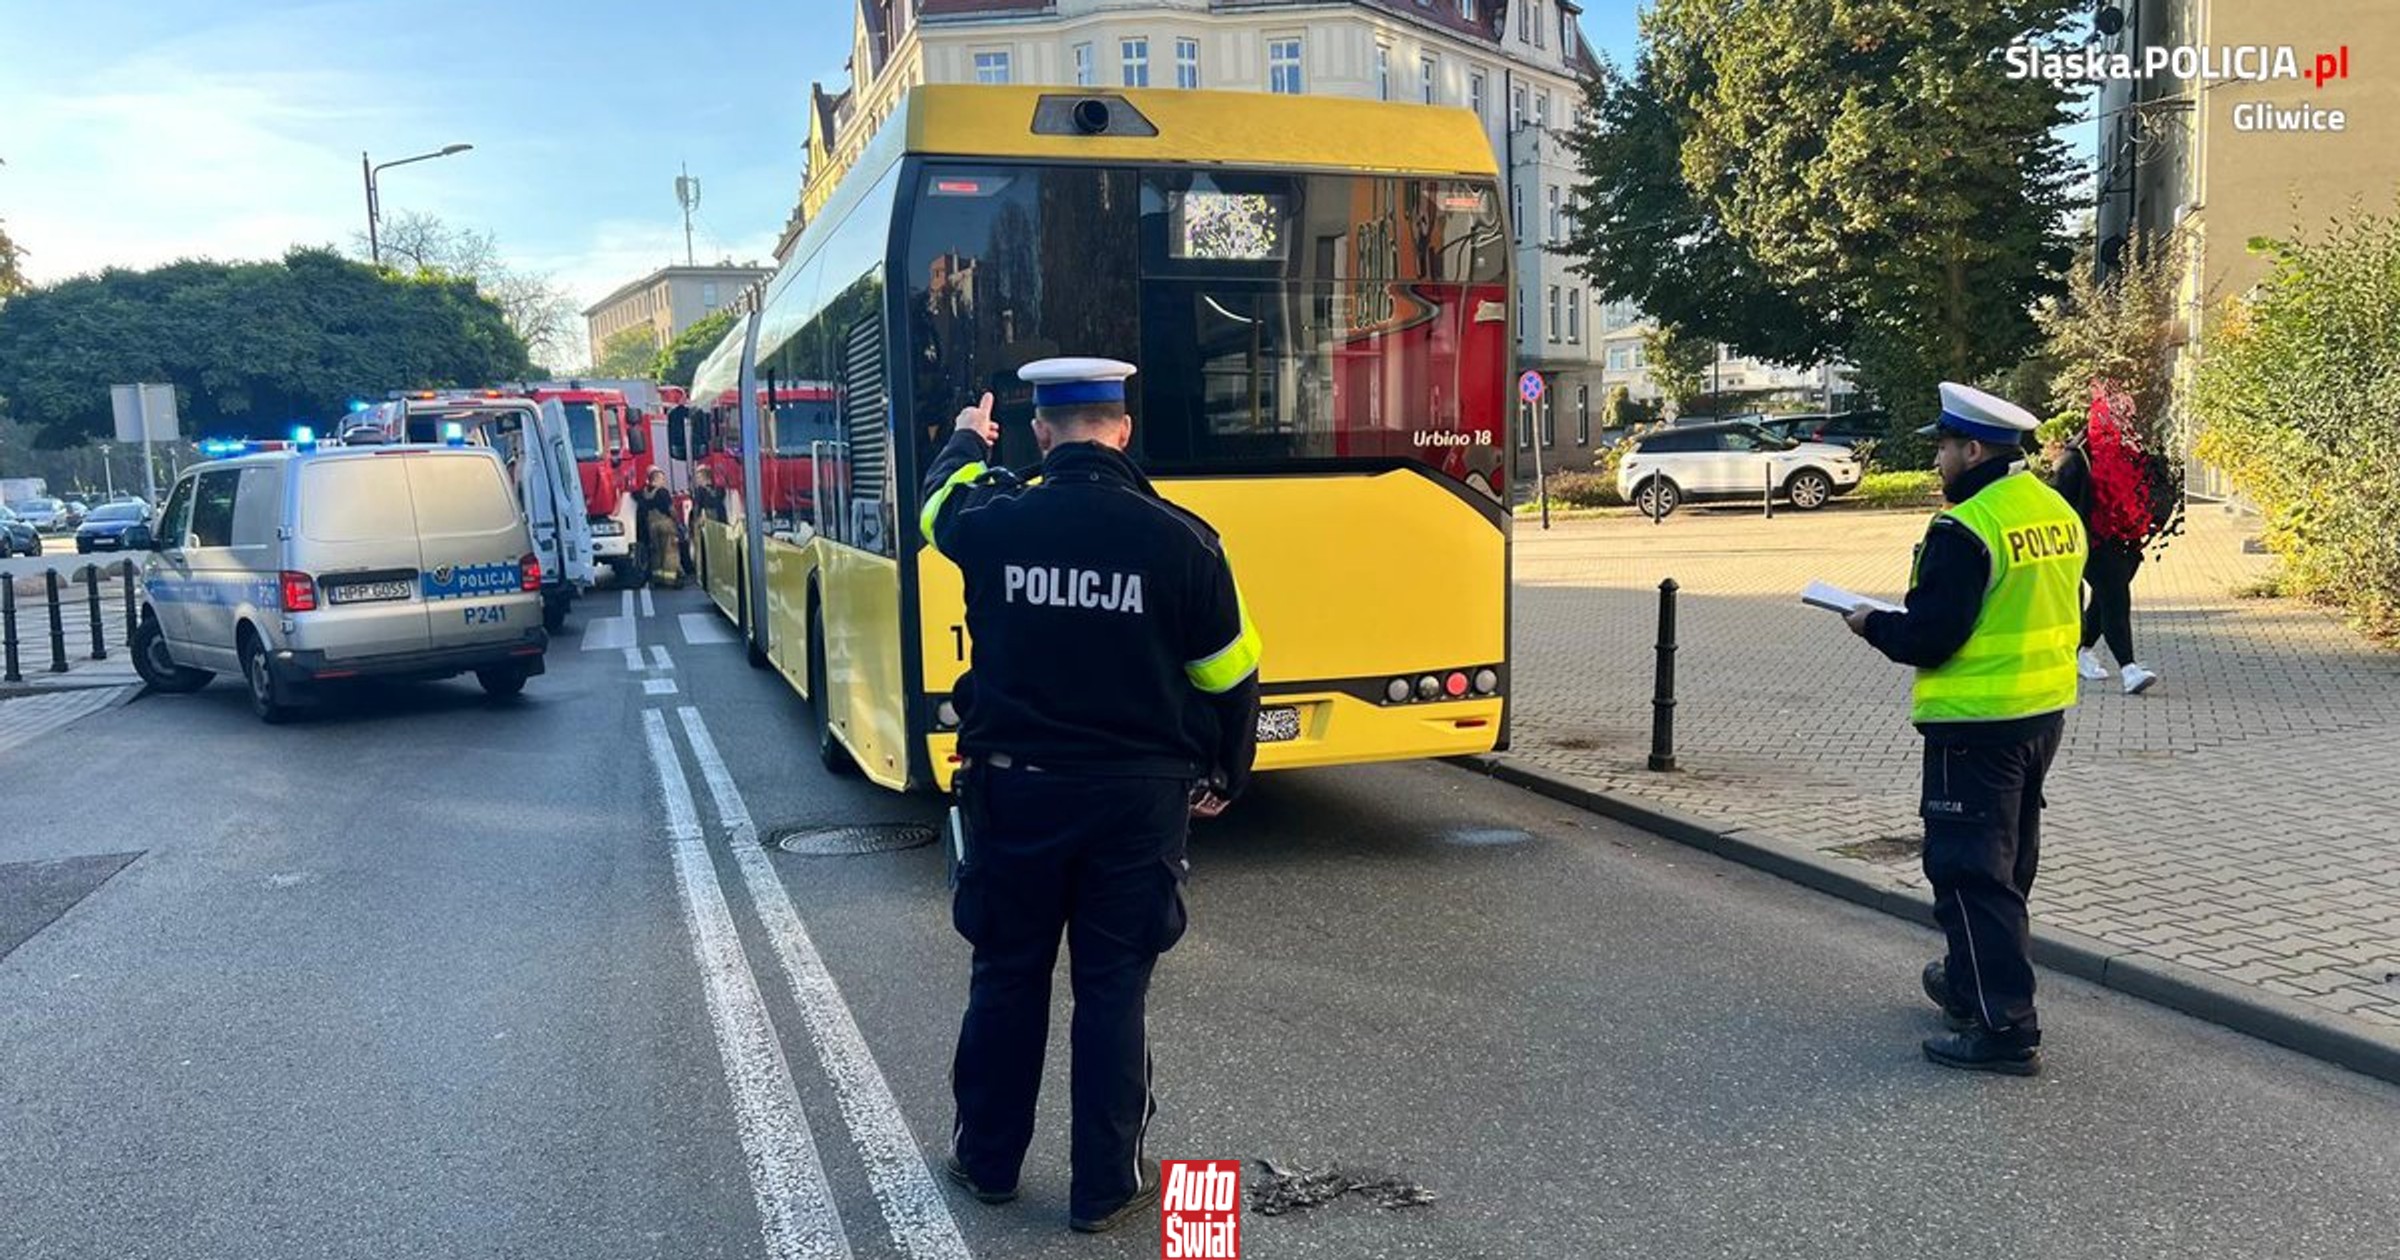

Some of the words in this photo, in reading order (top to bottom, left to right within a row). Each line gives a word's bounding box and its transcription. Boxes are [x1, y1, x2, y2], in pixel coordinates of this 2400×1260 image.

[1413, 430, 1470, 447] Urbino
[1474, 430, 1492, 446] 18
[459, 573, 516, 588] POLICJA
[337, 583, 370, 600] HPP
[1004, 565, 1144, 614] POLICJA
[464, 605, 507, 625] P241
